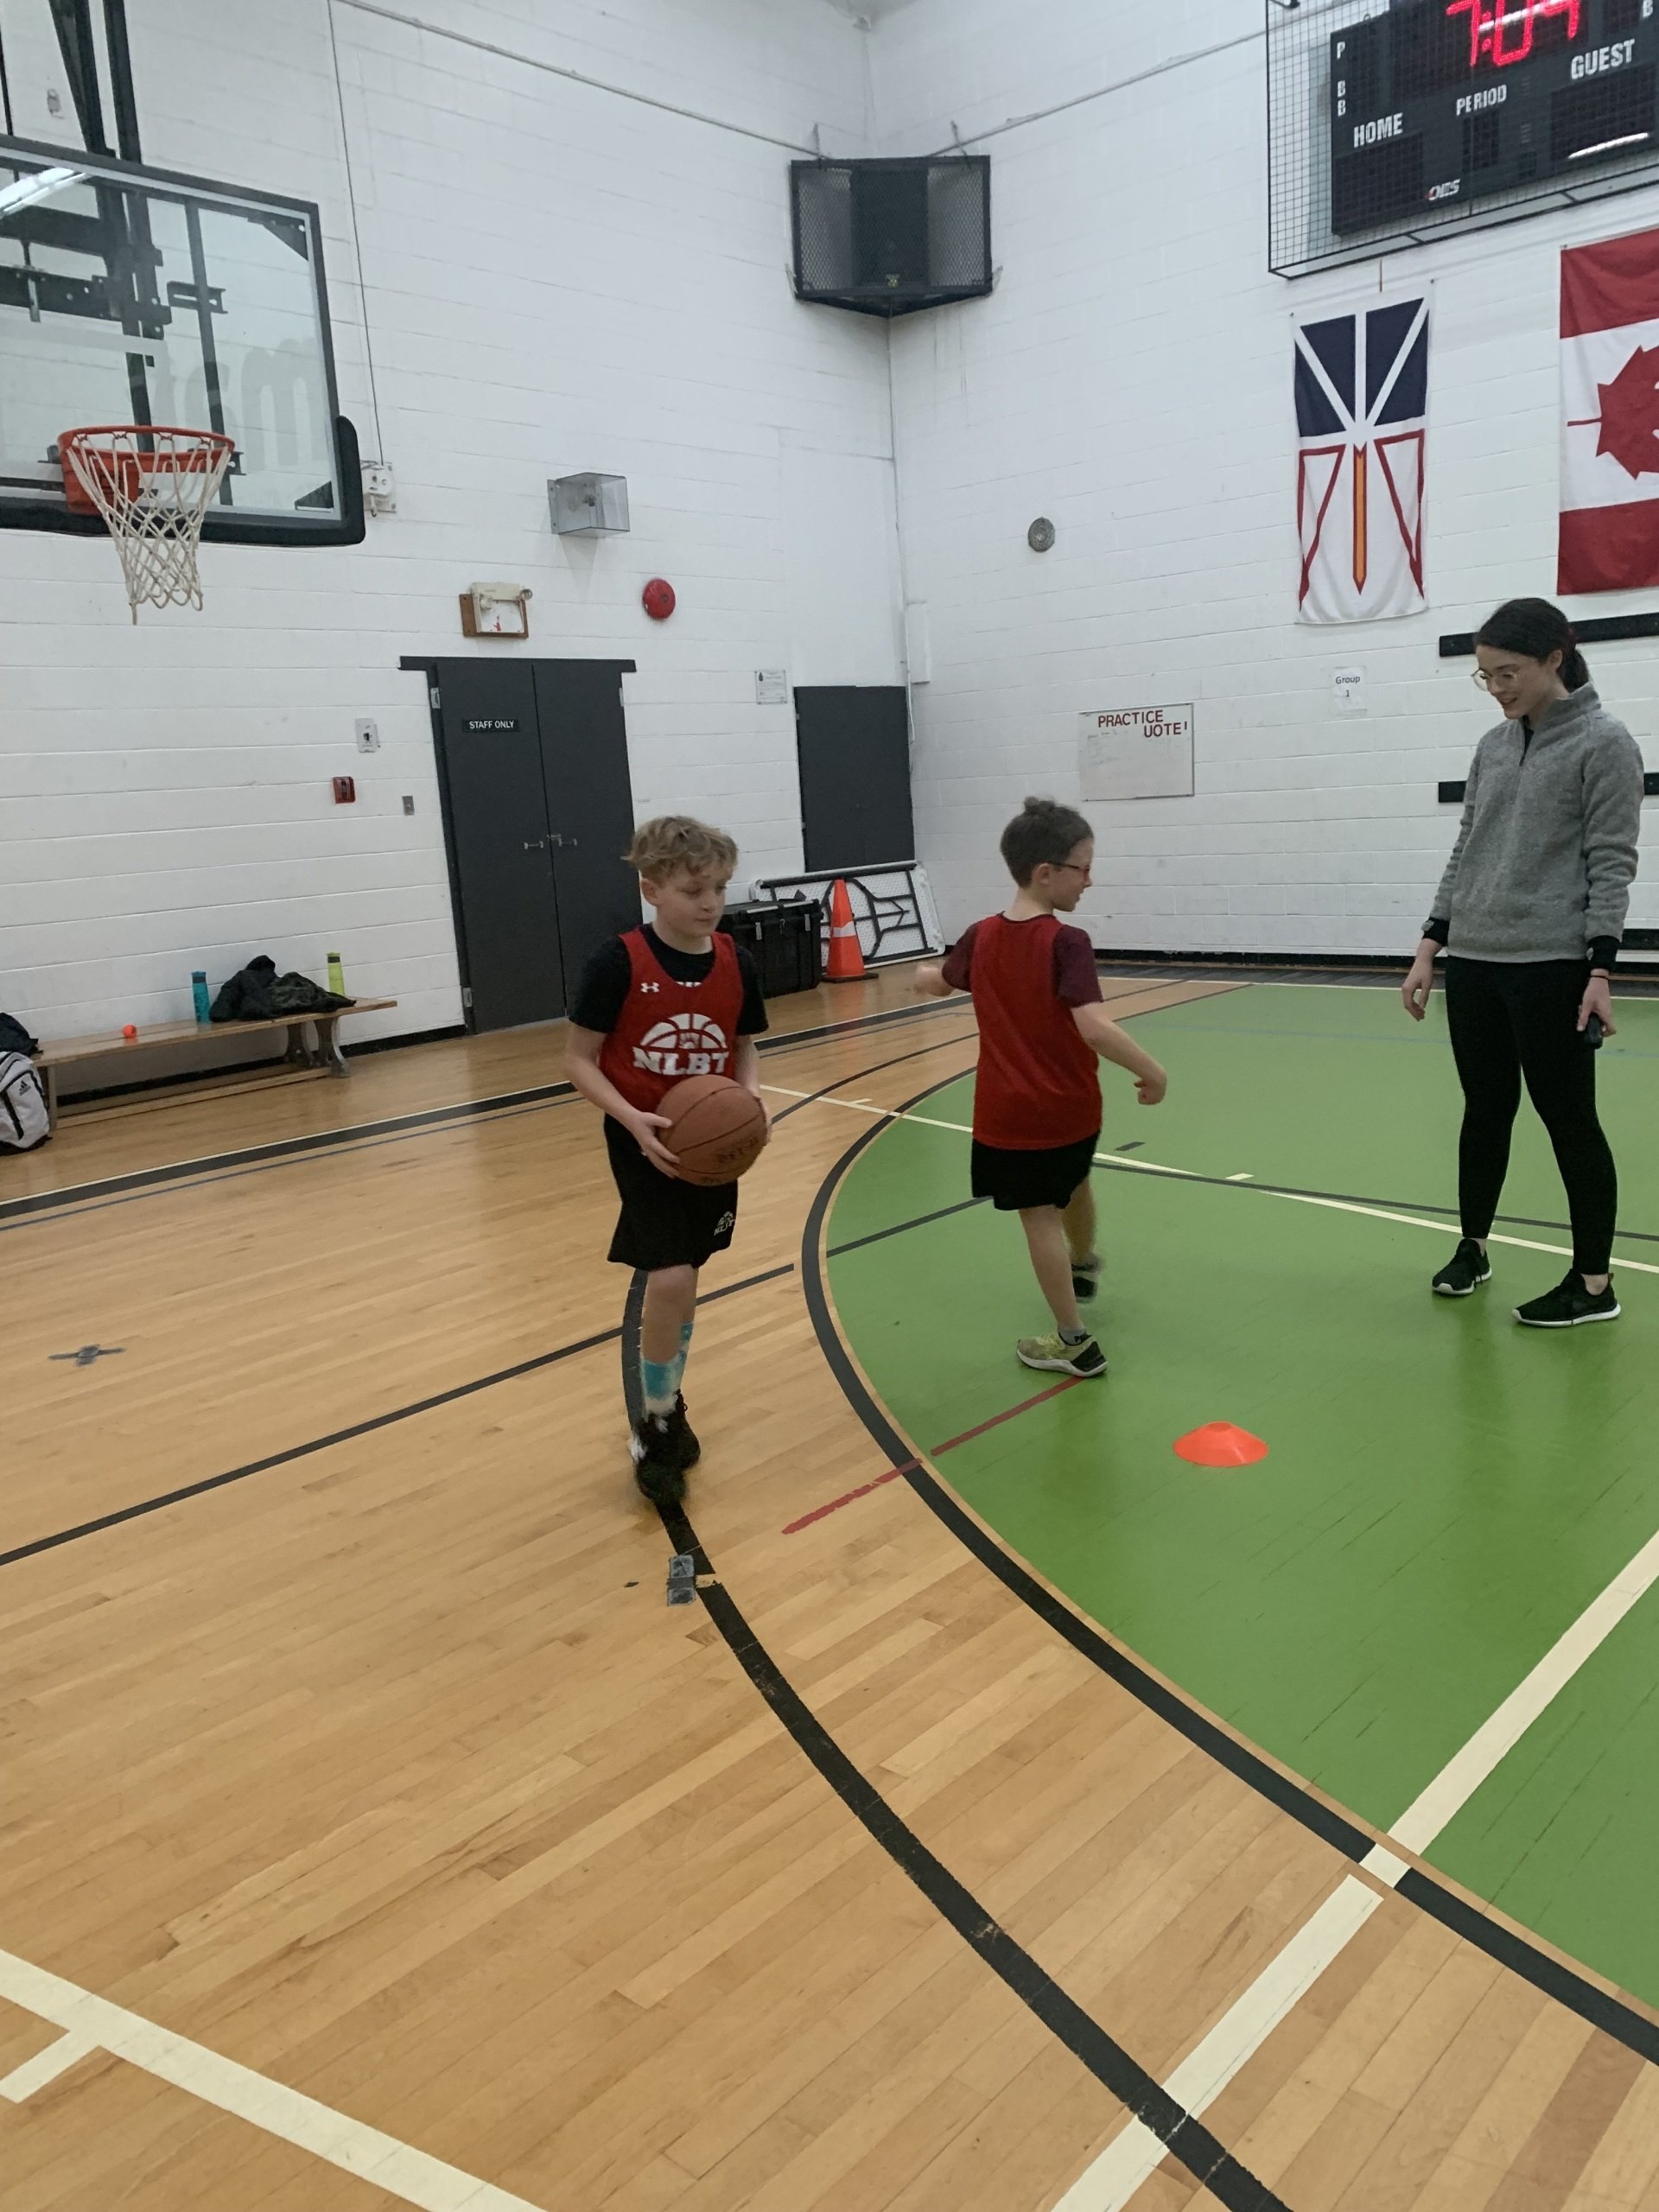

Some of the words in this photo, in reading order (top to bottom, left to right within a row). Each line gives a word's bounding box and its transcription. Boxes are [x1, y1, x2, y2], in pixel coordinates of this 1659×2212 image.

[1643, 0, 1654, 17] B
[1337, 41, 1346, 60] P
[1571, 39, 1635, 79] GUEST
[1337, 80, 1346, 98] B
[1338, 99, 1346, 117] B
[1456, 84, 1508, 116] PERIOD
[1353, 112, 1403, 148] HOME
[1335, 676, 1361, 684] Group
[469, 720, 493, 729] STAFF
[494, 720, 515, 729] ONLY
[1097, 709, 1164, 728] PRACTICE
[632, 1046, 730, 1076] NLBT
